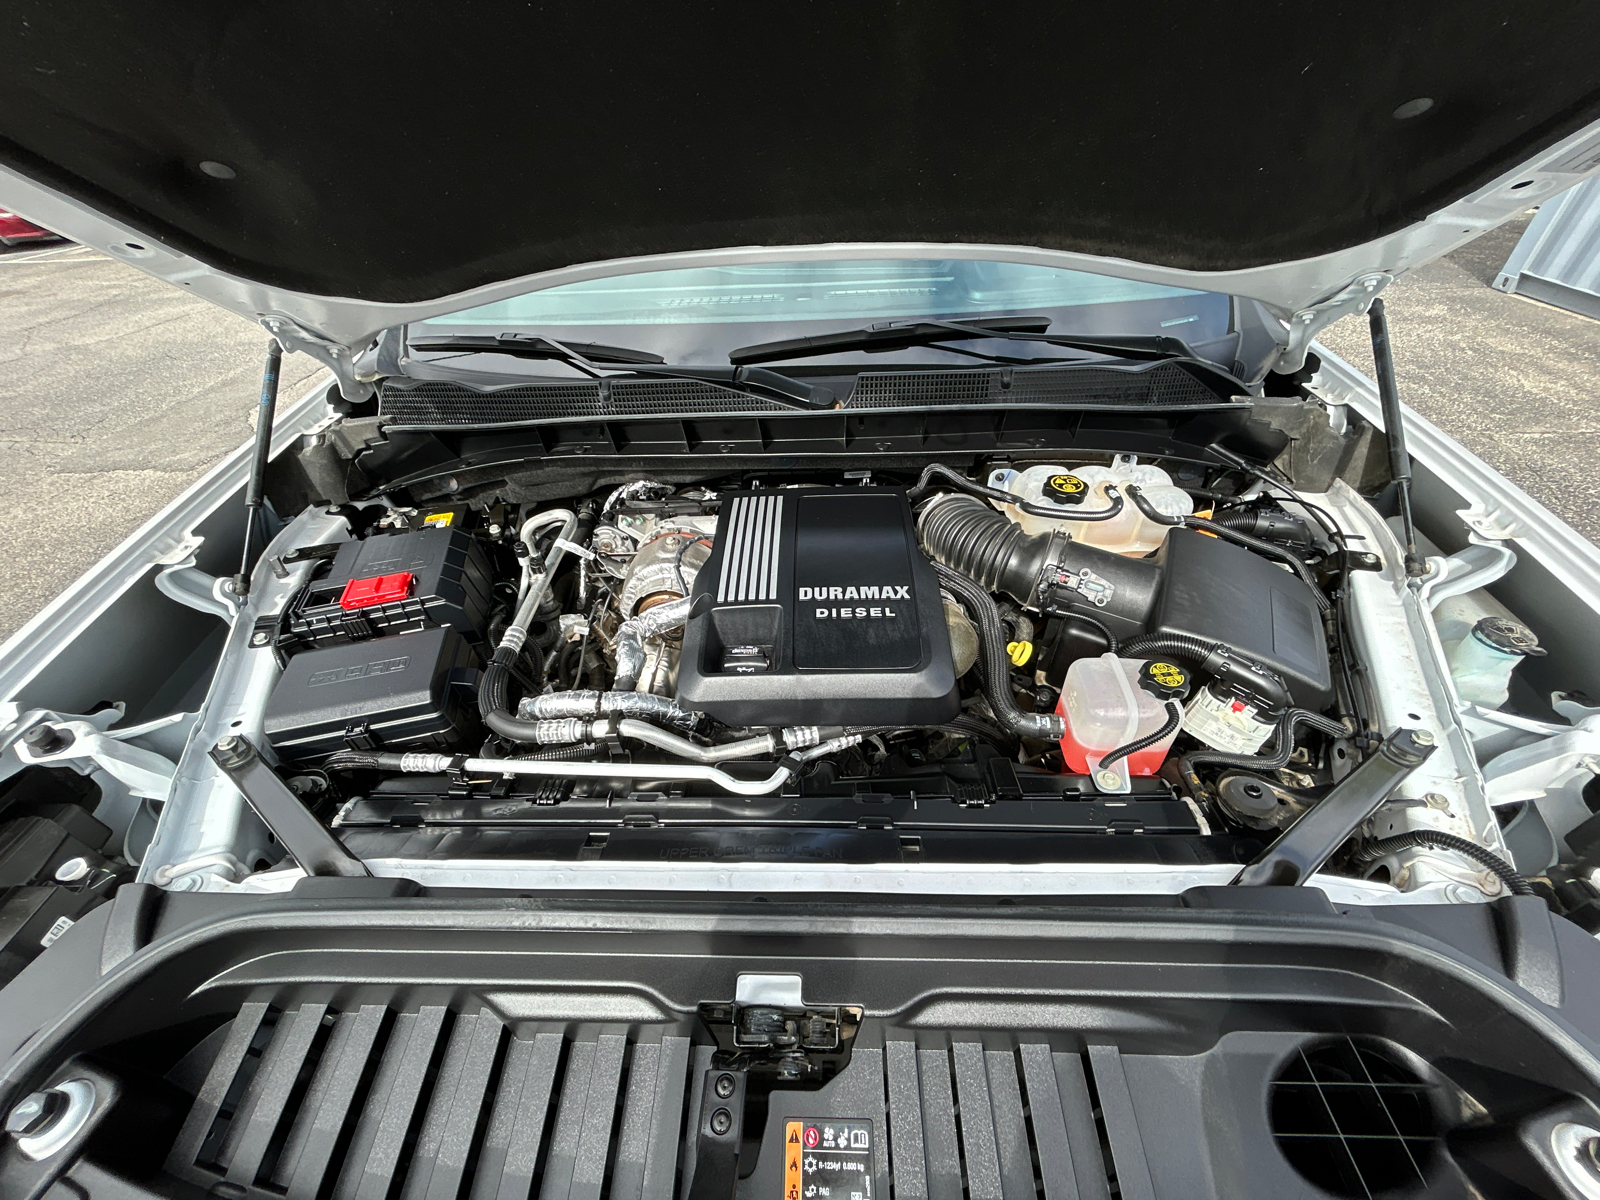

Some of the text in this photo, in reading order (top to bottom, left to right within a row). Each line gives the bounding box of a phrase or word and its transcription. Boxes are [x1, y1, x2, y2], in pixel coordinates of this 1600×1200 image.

[799, 586, 911, 600] DURAMAX
[815, 607, 896, 618] DIESEL
[659, 847, 709, 859] UPPER
[814, 846, 843, 859] FAN
[823, 1140, 835, 1148] AUTO
[819, 1162, 841, 1171] R-1234yf
[857, 1163, 864, 1172] kg
[819, 1187, 830, 1196] PAG
